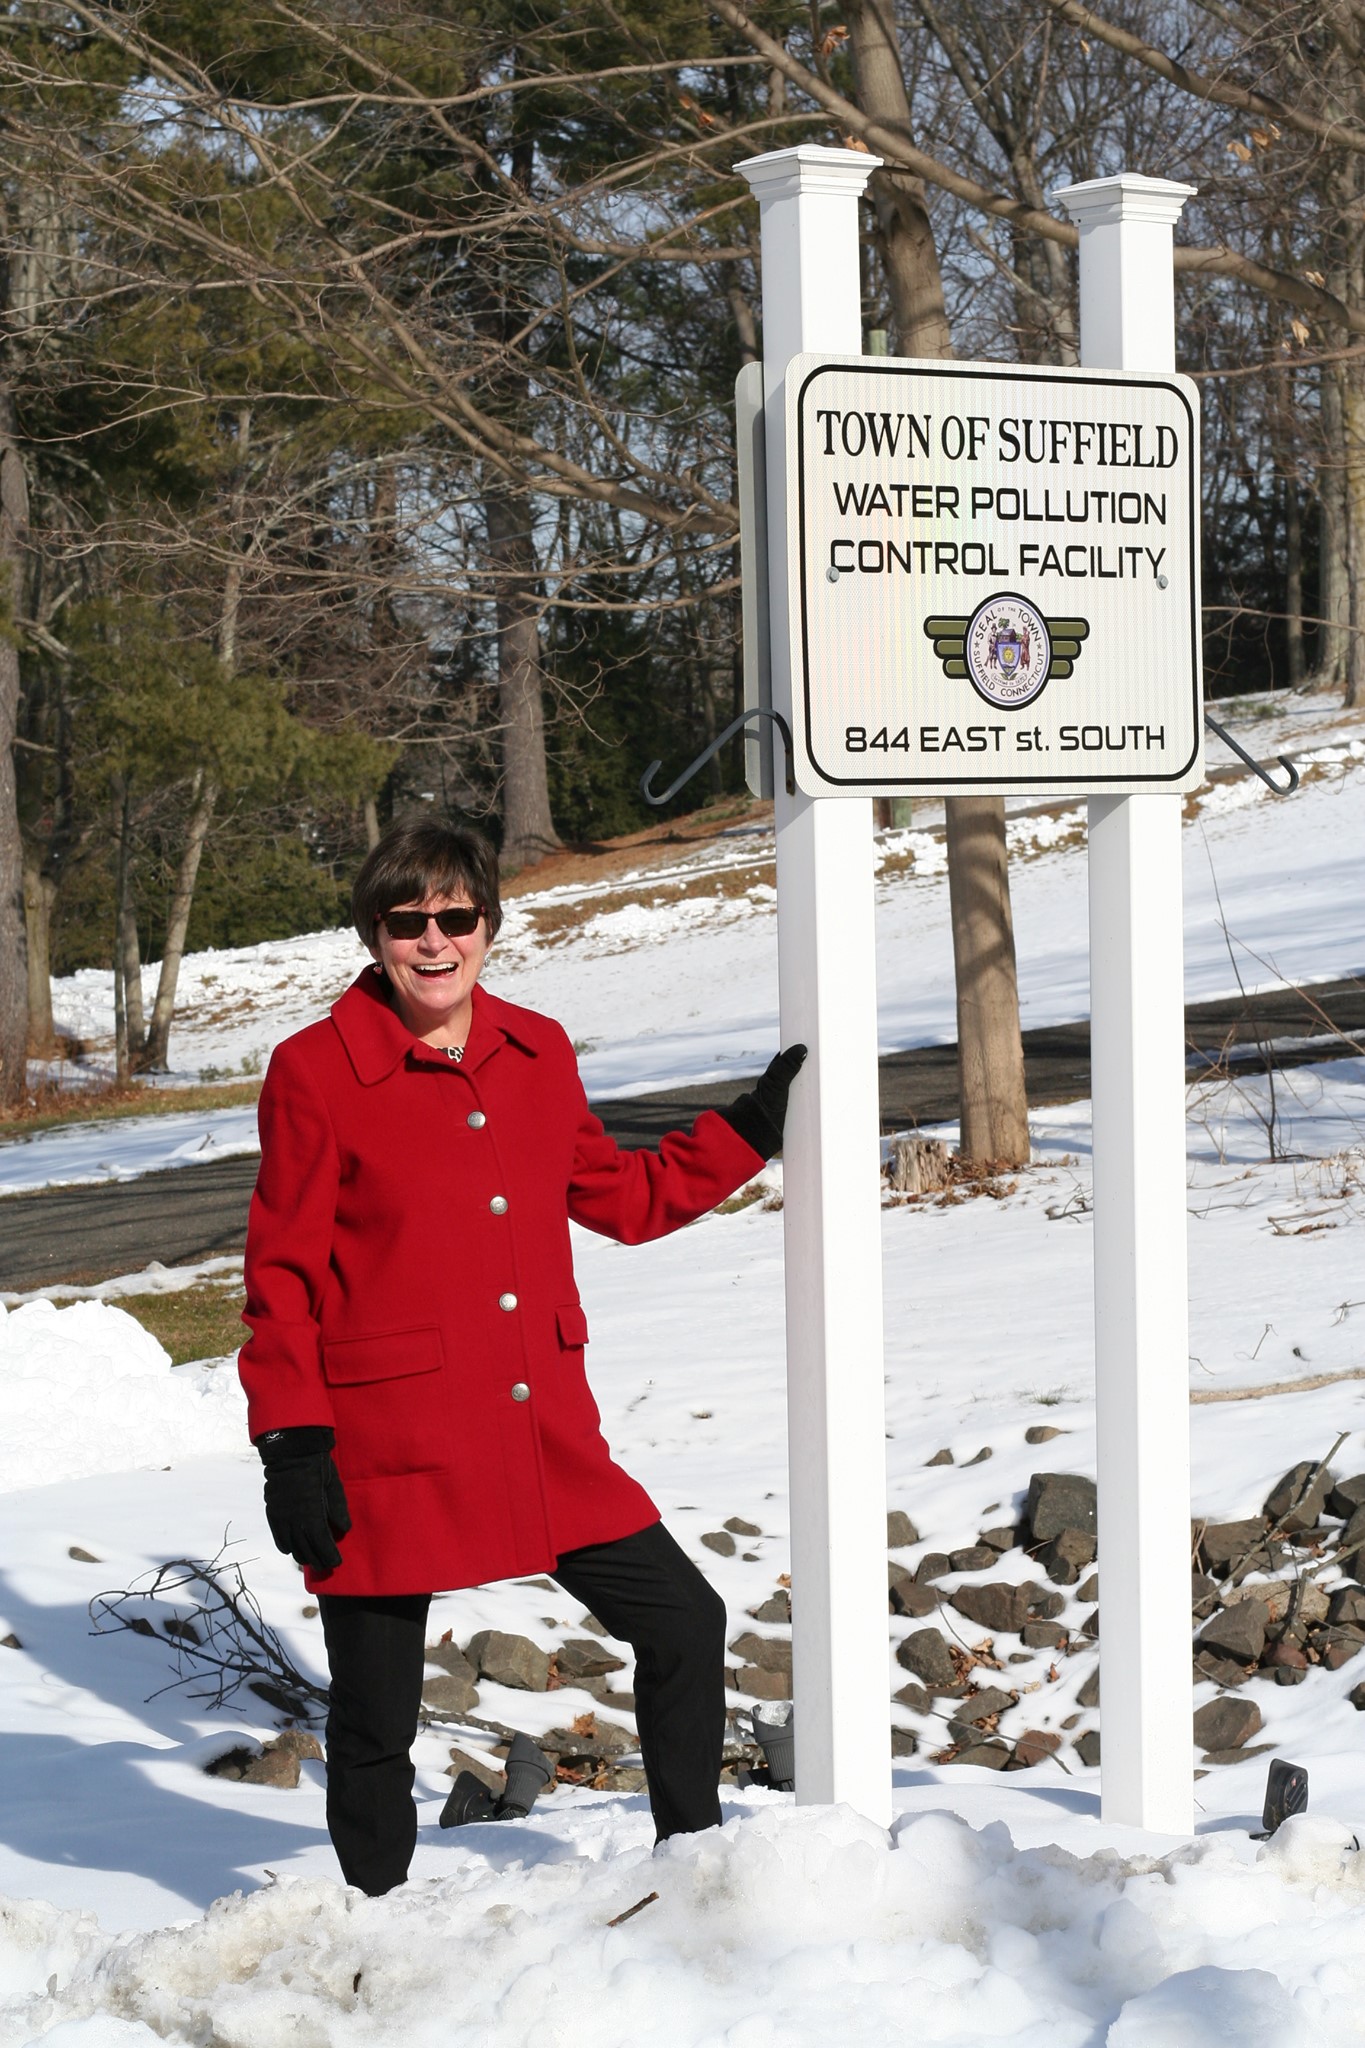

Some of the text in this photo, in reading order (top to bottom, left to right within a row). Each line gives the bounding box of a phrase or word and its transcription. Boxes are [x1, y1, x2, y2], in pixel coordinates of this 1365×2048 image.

[817, 410, 1178, 468] TOWN OF SUFFIELD
[833, 482, 1165, 524] WATER POLLUTION
[831, 540, 1165, 579] CONTROL FACILITY
[975, 610, 997, 640] SEAL
[1018, 608, 1041, 642] TOWN
[974, 650, 1044, 697] SUFFIELD CONNECTICUT
[846, 726, 1164, 752] 844 EAST st. SOUTH
